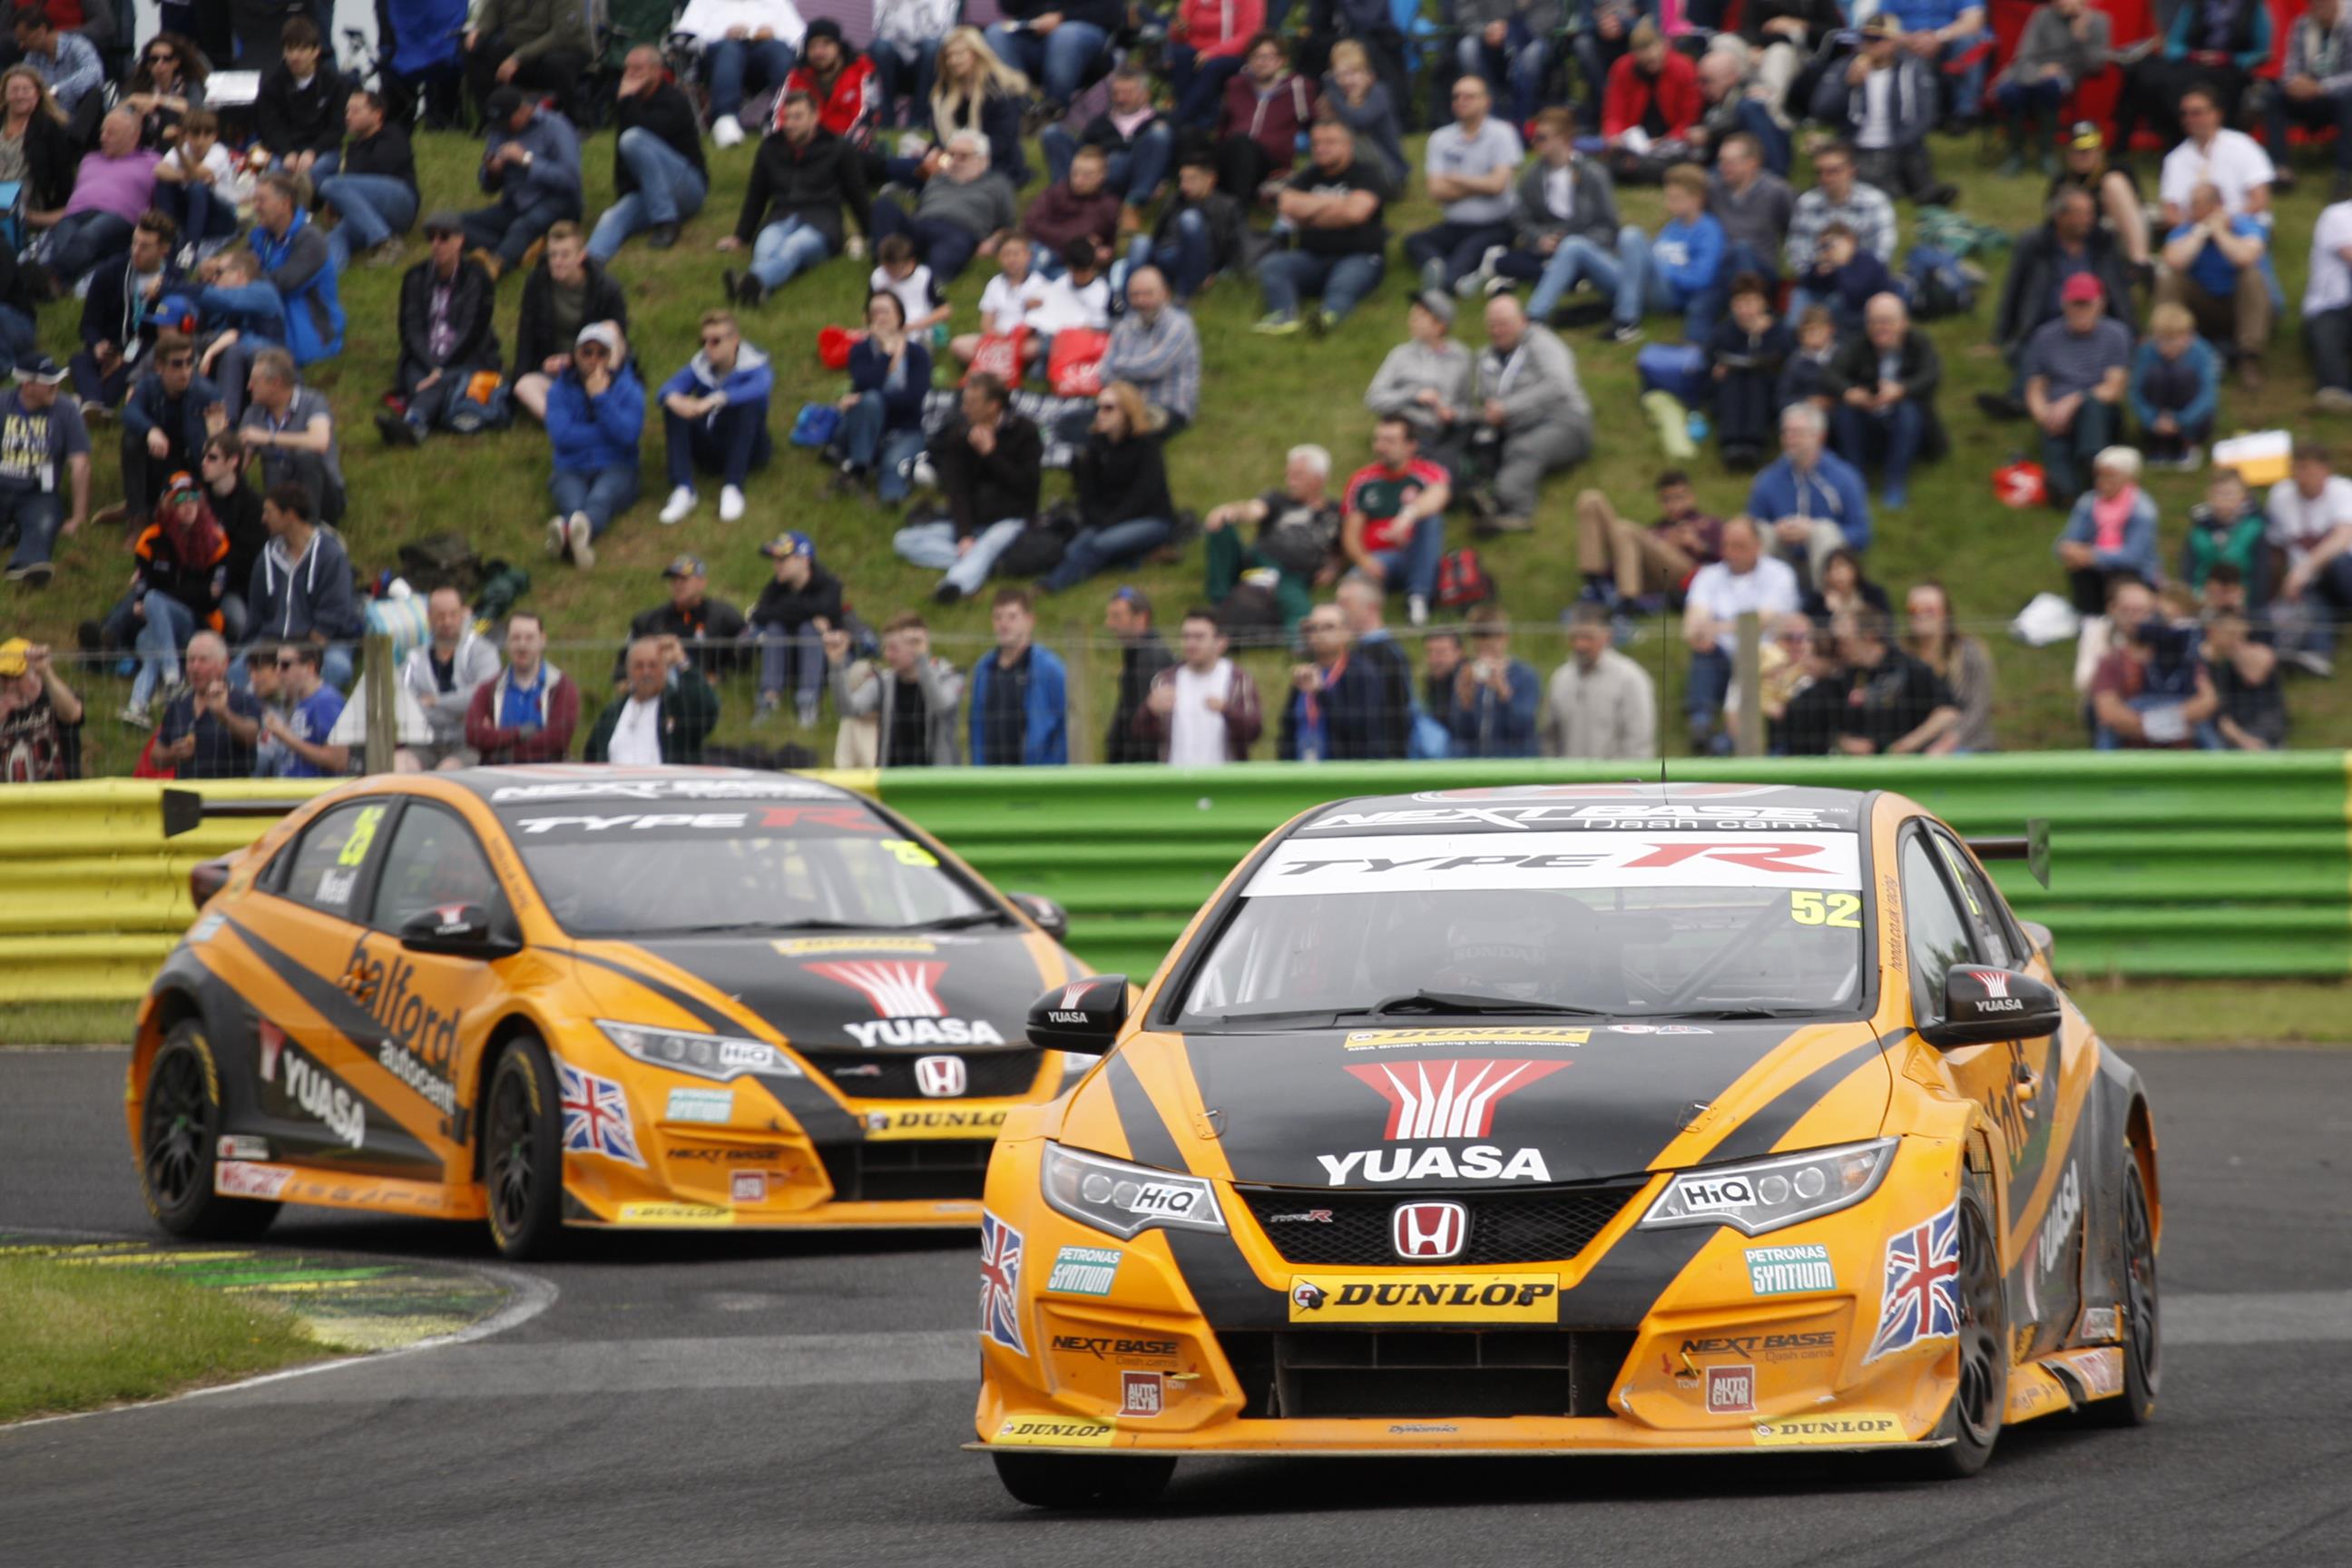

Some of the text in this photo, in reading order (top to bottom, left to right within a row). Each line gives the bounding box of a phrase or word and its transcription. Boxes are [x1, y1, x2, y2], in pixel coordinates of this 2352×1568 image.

[516, 807, 889, 833] TYPE R
[1301, 804, 1826, 829] NEXT BASE
[1583, 818, 1841, 829] Dash cams
[1279, 842, 1844, 876] TYPE R
[1790, 890, 1861, 928] 52
[1048, 1011, 1088, 1023] YUASA
[1975, 998, 2024, 1013] YUASA
[842, 1017, 1006, 1047] YUASA
[284, 1048, 366, 1150] YUASA
[897, 1112, 1007, 1127] DUNLO
[1317, 1145, 1552, 1186] YUASA
[1136, 1187, 1194, 1212] HiQ
[1684, 1181, 1751, 1206] HiQ
[1057, 1247, 1120, 1264] PETRONAS
[1745, 1246, 1827, 1263] PETRONAS
[1047, 1264, 1115, 1293] SYNTIUM
[1752, 1262, 1833, 1293] SYNTIUM
[1334, 1283, 1555, 1306] DUNLOP
[1051, 1335, 1179, 1360] NEXT BASE
[1680, 1331, 1836, 1358] NEXT BASE
[1801, 1348, 1834, 1358] cams
[1677, 1378, 1700, 1389] TOW
[1713, 1377, 1749, 1391] AUTO
[1712, 1389, 1749, 1406] GLYM
[1014, 1424, 1112, 1437] DUNLOP
[1780, 1421, 1894, 1436] DUNLOP
